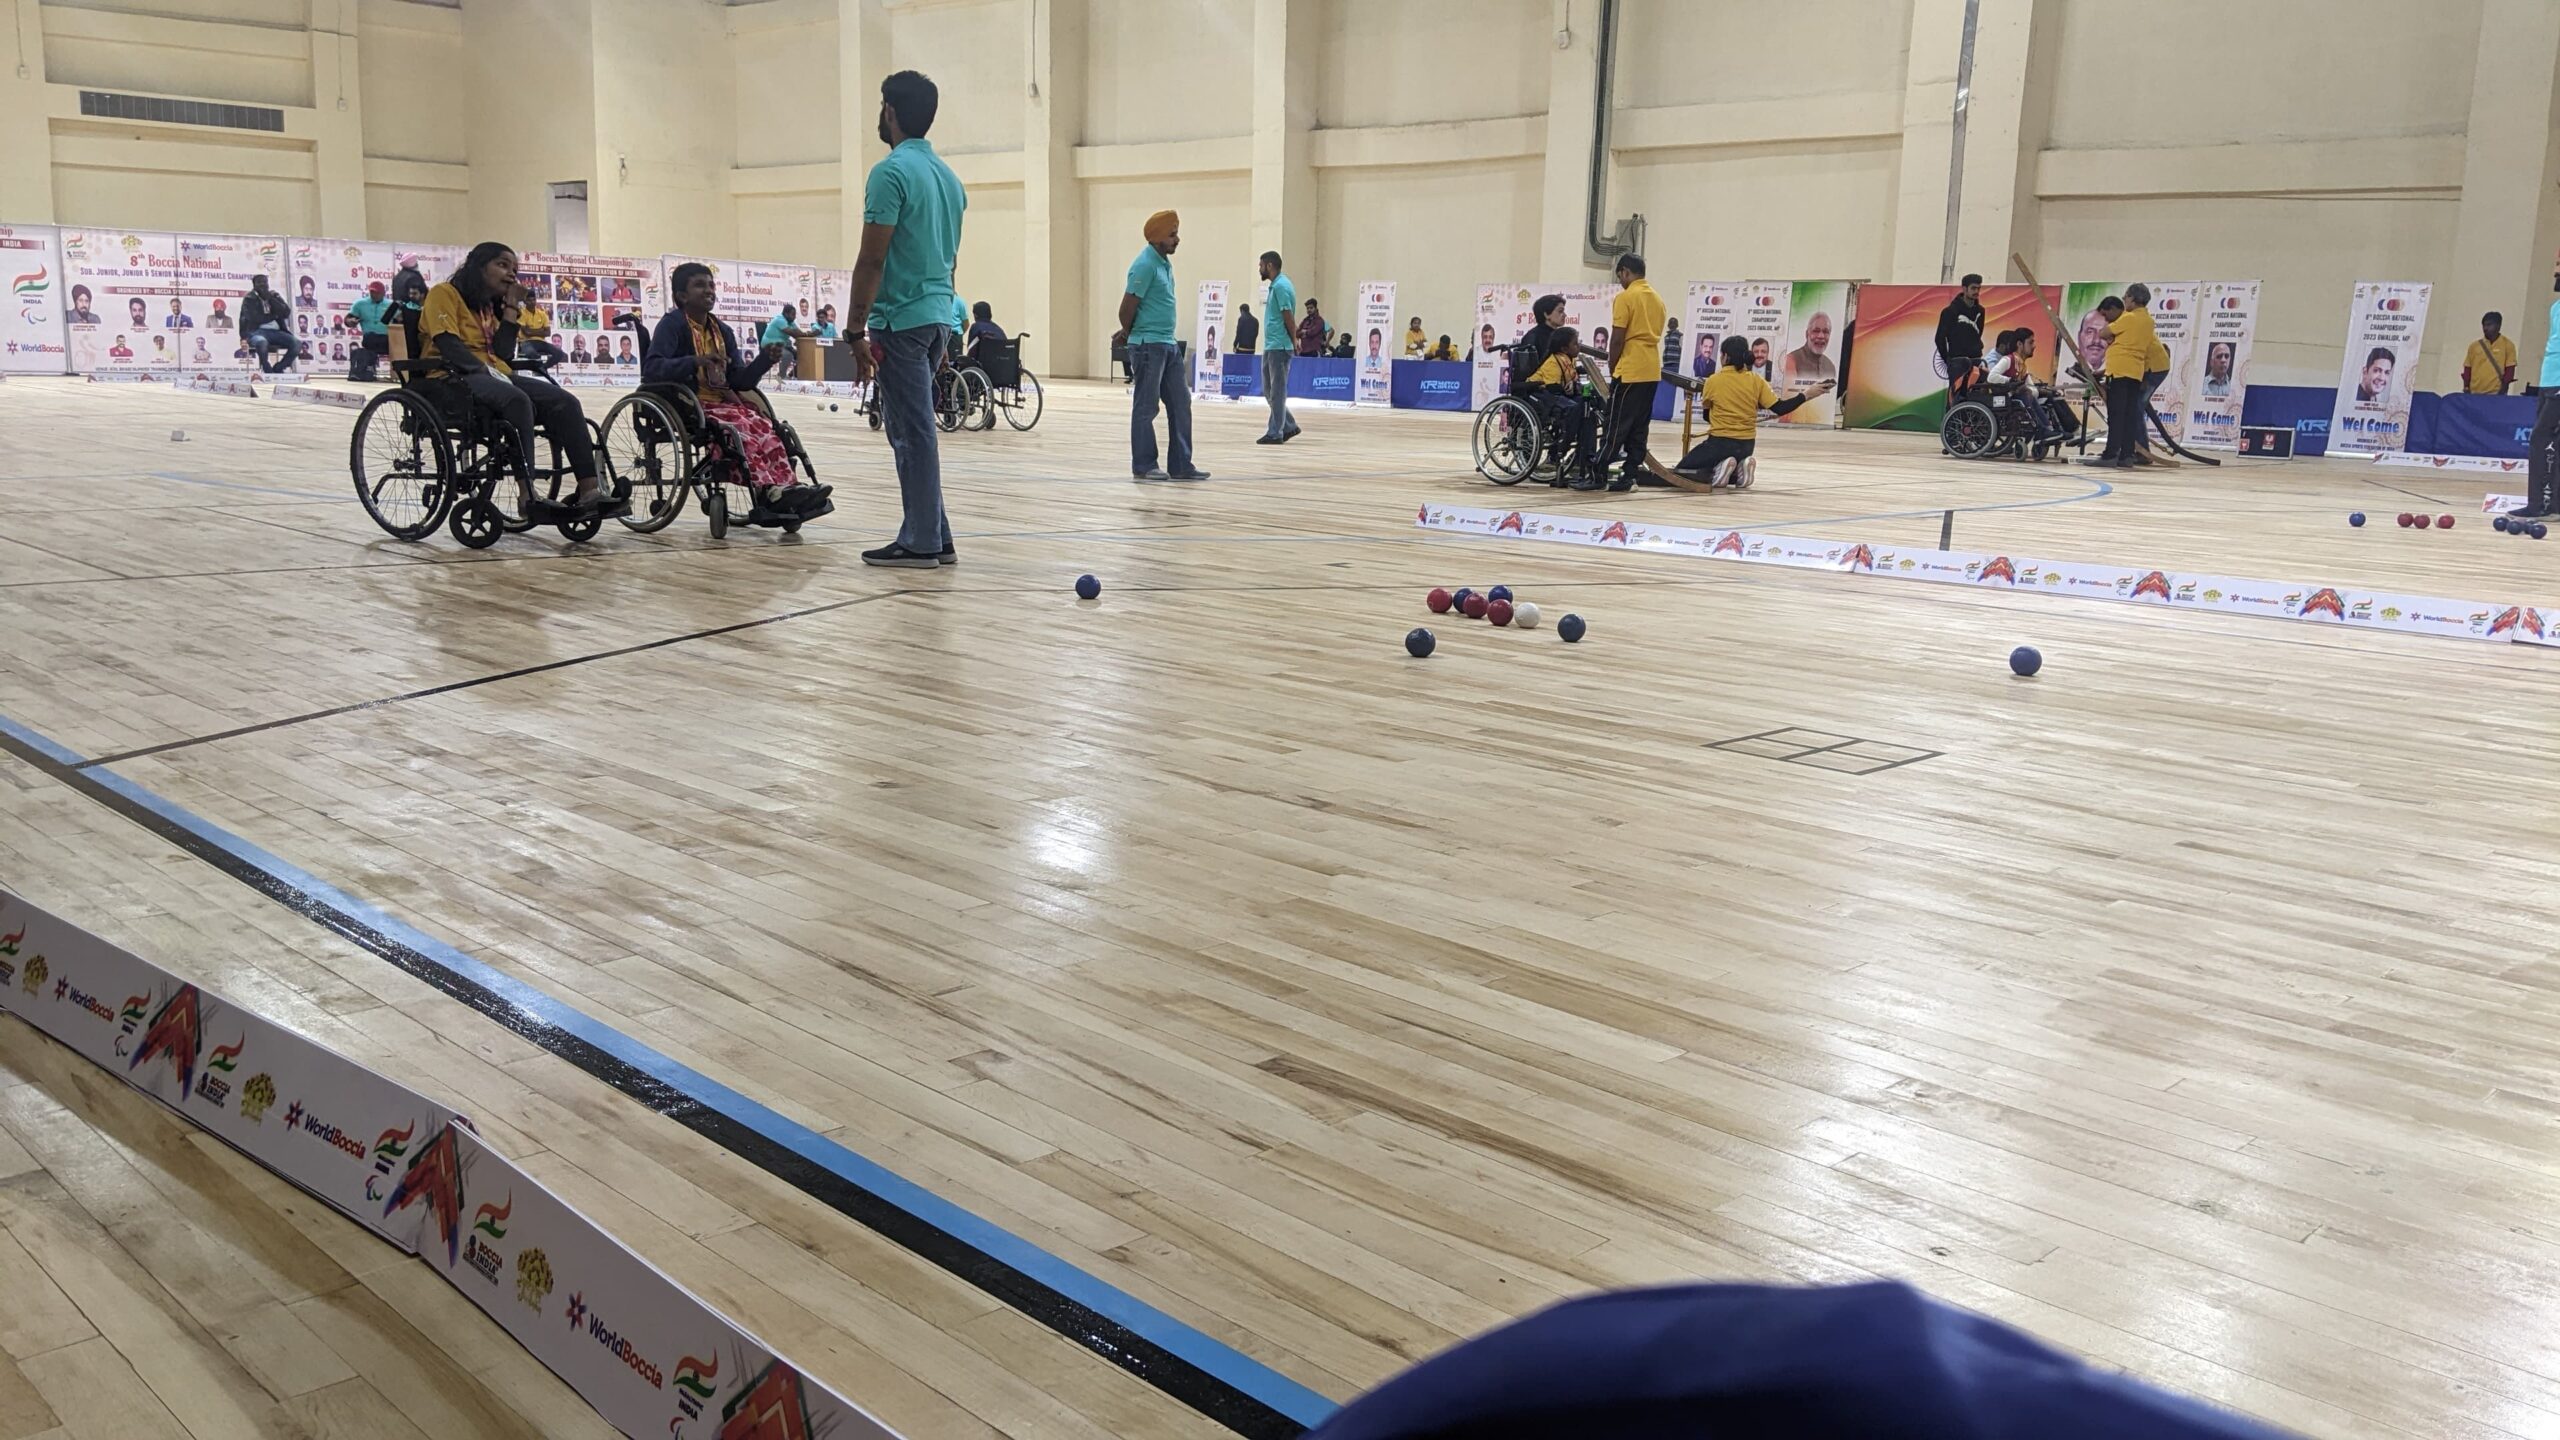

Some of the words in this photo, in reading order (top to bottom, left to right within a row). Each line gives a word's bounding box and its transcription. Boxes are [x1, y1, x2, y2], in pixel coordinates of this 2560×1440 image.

[193, 243, 233, 251] WorldBoccia
[130, 253, 145, 266] 8th
[148, 254, 180, 268] Boccia
[182, 255, 222, 269] National
[536, 252, 558, 263] Boccia
[560, 254, 586, 264] National
[588, 255, 633, 268] Championship
[351, 266, 364, 278] 8th
[368, 267, 394, 280] Boccia
[723, 282, 745, 294] Boccia
[746, 283, 773, 296] National
[20, 343, 65, 353] WorldBoccia
[2194, 410, 2210, 424] Wel
[2212, 412, 2235, 425] Come
[2342, 416, 2365, 432] Wel
[2367, 418, 2400, 432] Come
[2242, 596, 2278, 605] WorldBoccia
[2423, 614, 2464, 624] WorldBoccia
[69, 986, 114, 1022] WorldBoccia
[209, 1076, 231, 1095] BOCCIA
[304, 1114, 366, 1160] WorldBoccia
[476, 1252, 497, 1275] INDIA
[478, 1242, 502, 1269] BOCCIA
[589, 1312, 663, 1391] WorldBoccia
[678, 1398, 698, 1422] INDIA
